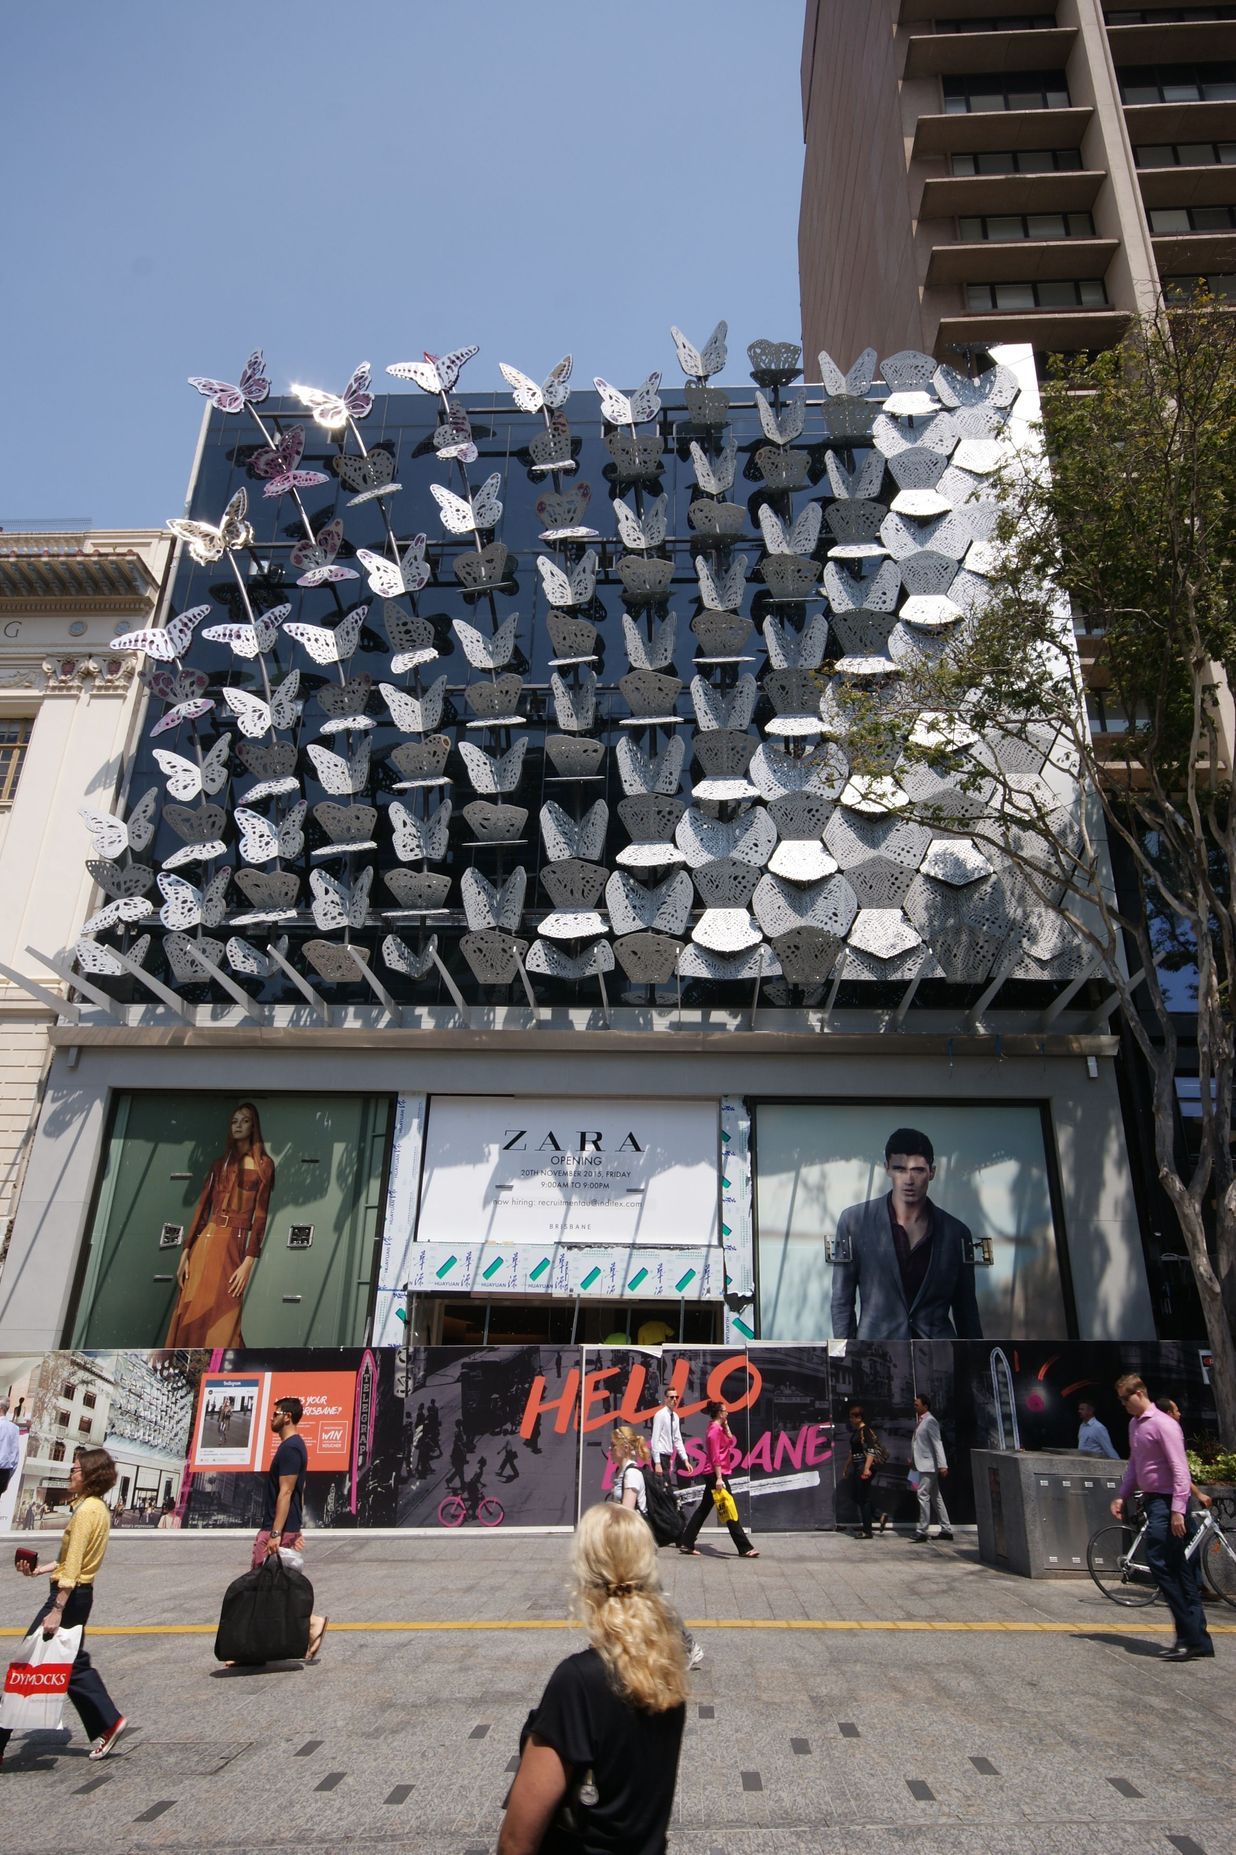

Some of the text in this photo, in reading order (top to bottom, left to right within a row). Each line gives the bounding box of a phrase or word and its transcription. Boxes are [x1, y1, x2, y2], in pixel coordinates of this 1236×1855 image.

[502, 1130, 645, 1152] ZARA
[551, 1155, 602, 1166] OPENING
[511, 1198, 535, 1207] hiring:
[538, 1198, 642, 1208] recruitmentau@inditex.com
[306, 1395, 327, 1406] YOUR
[519, 1354, 762, 1440] HELLO
[303, 1406, 342, 1415] RISBANE?
[322, 1430, 343, 1440] WIN
[9, 1672, 66, 1685] DYMOCKS
